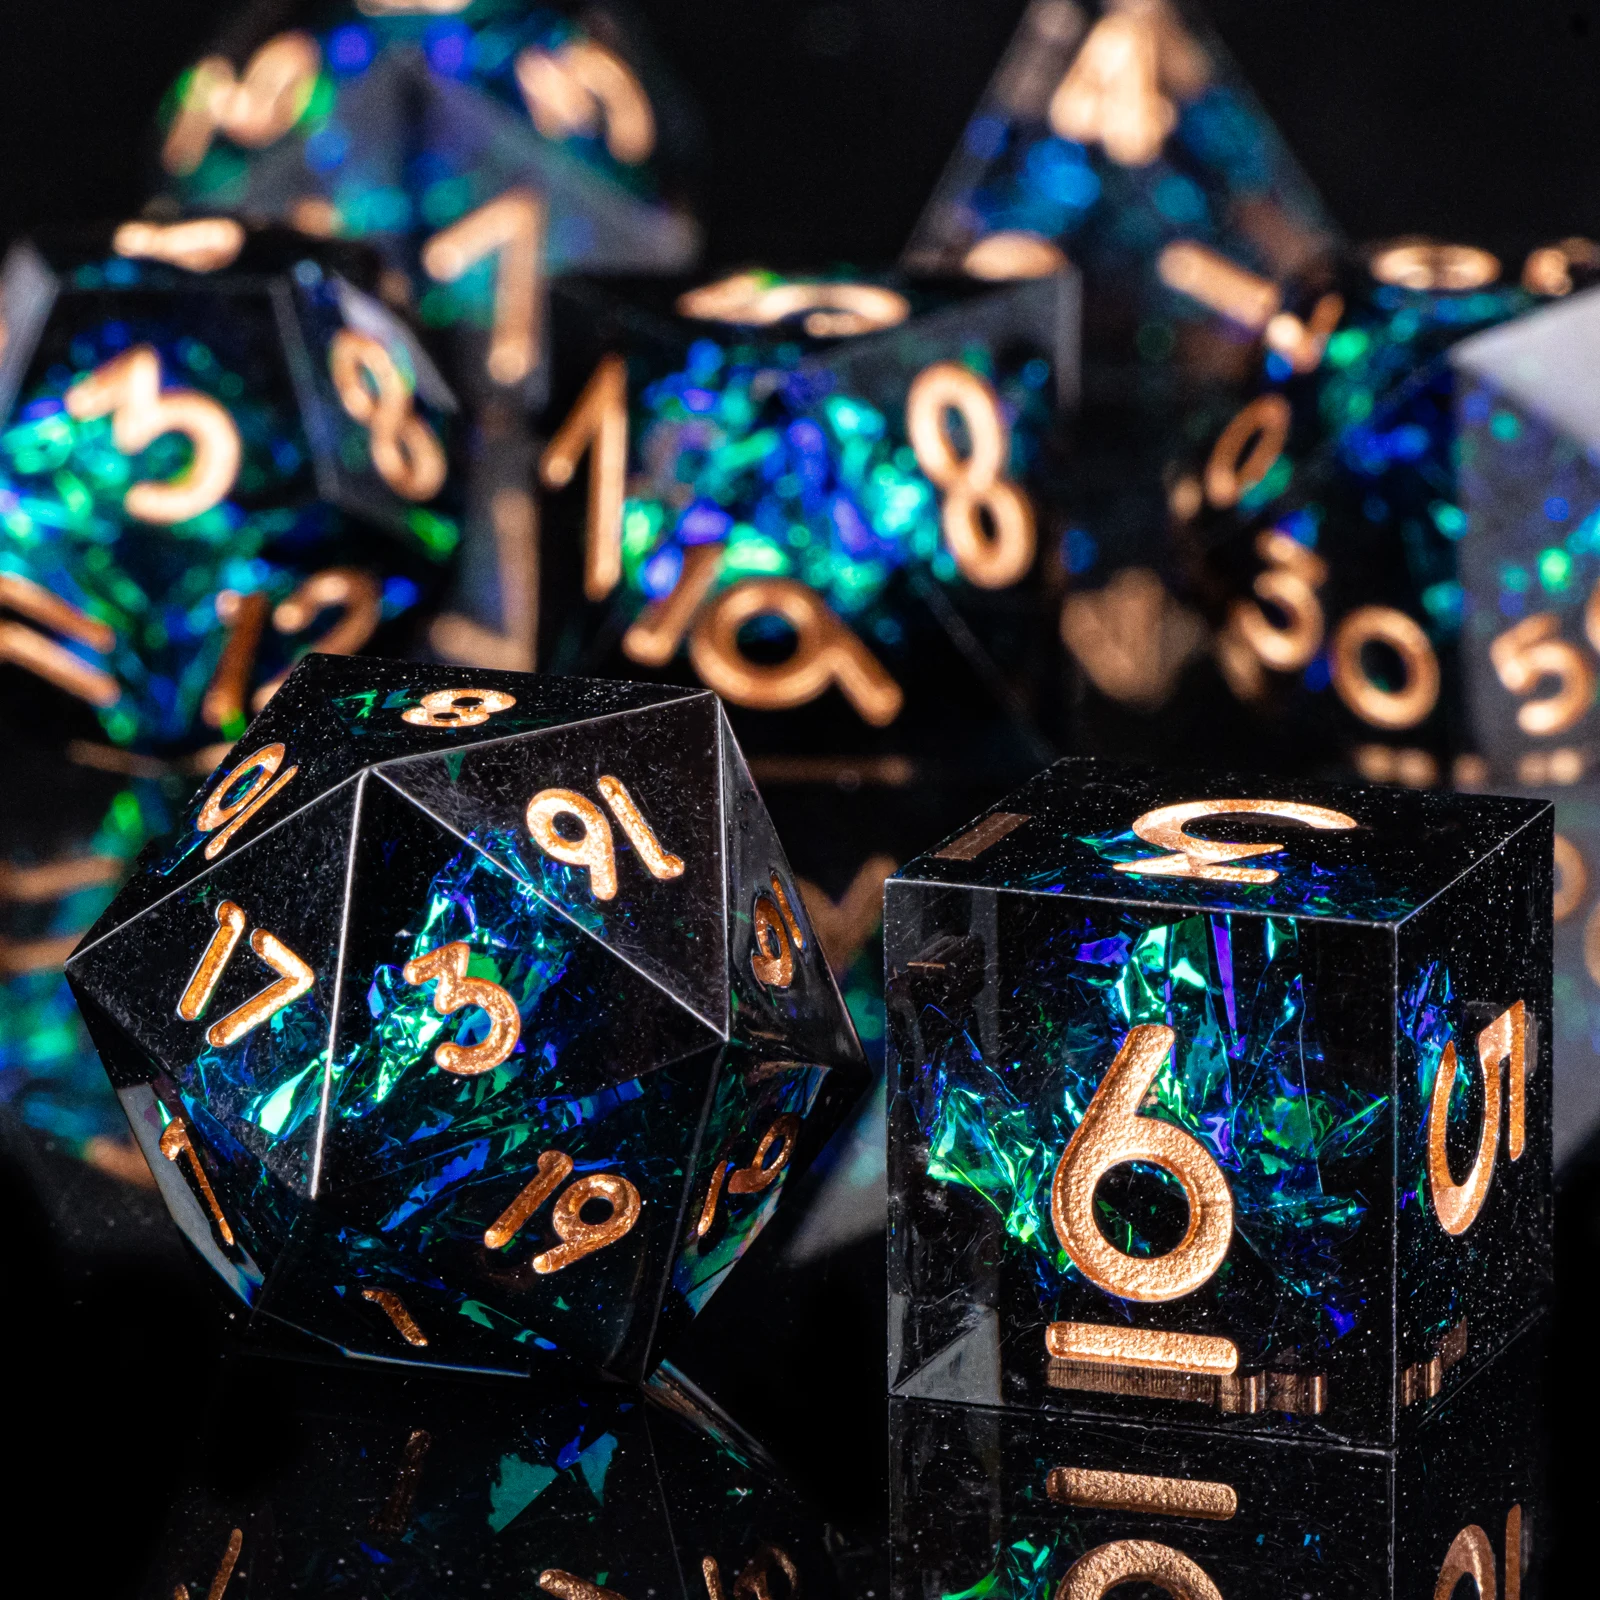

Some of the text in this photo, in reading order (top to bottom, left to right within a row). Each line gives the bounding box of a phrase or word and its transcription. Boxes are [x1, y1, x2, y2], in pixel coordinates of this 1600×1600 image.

[64, 344, 242, 524] 3
[328, 326, 448, 500] 8
[542, 356, 628, 602] 1
[905, 360, 1037, 590] 8
[400, 687, 517, 728] 8
[1112, 799, 1359, 883] 3
[176, 900, 314, 1049] 17
[402, 941, 522, 1076] 3
[1051, 1023, 1235, 1303] 6
[1427, 999, 1527, 1236] 5
[483, 1150, 643, 1276] 19
